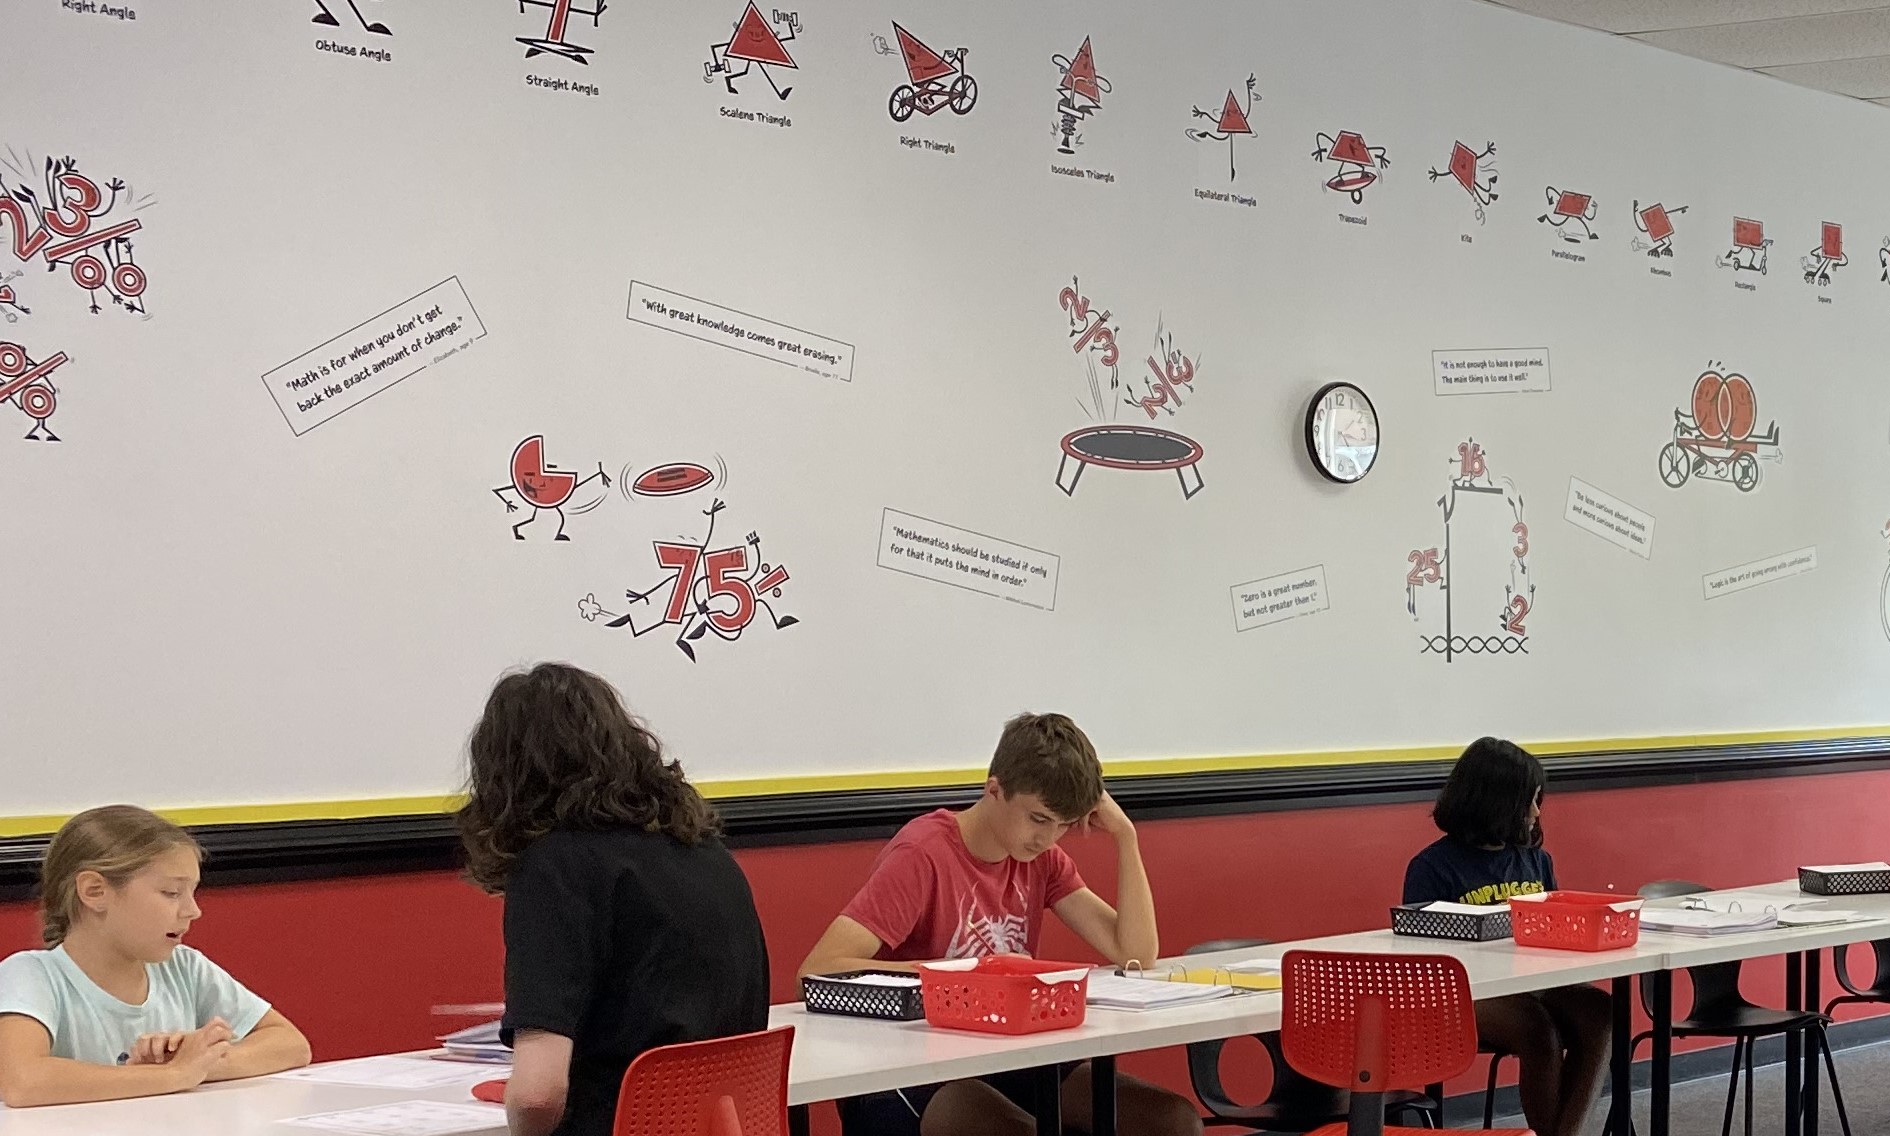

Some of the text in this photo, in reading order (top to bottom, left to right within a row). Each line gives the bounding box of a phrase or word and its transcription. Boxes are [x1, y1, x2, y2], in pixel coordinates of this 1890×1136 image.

[62, 0, 136, 20] Right Angle
[315, 40, 392, 62] Obtuse Angle
[526, 75, 600, 96] Straight Angle
[720, 106, 792, 128] Scalene Triangle
[900, 136, 955, 154] Right Triangle
[1051, 164, 1115, 184] Isosceles Triangle
[1194, 188, 1257, 207] Equilateral Triangle
[318, 365, 330, 376] is
[330, 356, 347, 372] for
[349, 342, 375, 362] when
[376, 331, 396, 349] you
[396, 314, 424, 337] don't
[425, 304, 443, 323] get
[669, 308, 694, 323] great
[697, 314, 745, 337] knowledge
[747, 331, 776, 346] comes
[778, 339, 802, 354] great
[297, 316, 463, 412] back the exact amount of change."
[1449, 361, 1455, 369] is
[1456, 361, 1466, 369] not
[1467, 360, 1487, 369] enough
[1488, 360, 1495, 368] to
[1496, 359, 1509, 368] have
[1515, 359, 1528, 368] good
[1442, 376, 1453, 384] The
[1468, 375, 1483, 384] thing
[1490, 374, 1497, 382] to
[1335, 392, 1345, 407] 12
[1314, 424, 1320, 437] 9
[1458, 442, 1486, 477] 16
[891, 543, 904, 555] for
[906, 548, 925, 561] that
[926, 553, 933, 562] it
[935, 557, 953, 568] puts
[956, 561, 969, 573] the
[971, 566, 990, 578] mind
[992, 571, 999, 580] in
[951, 543, 978, 557] should
[980, 550, 989, 561] be
[991, 554, 1020, 569] studied
[1030, 565, 1047, 578] only
[1407, 548, 1441, 587] 25
[1260, 590, 1266, 599] is
[1273, 584, 1291, 597] great
[1243, 608, 1255, 618] but
[1256, 605, 1268, 615] not
[1269, 600, 1293, 613] greater
[1294, 596, 1309, 605] than
[1508, 594, 1529, 637] 2
